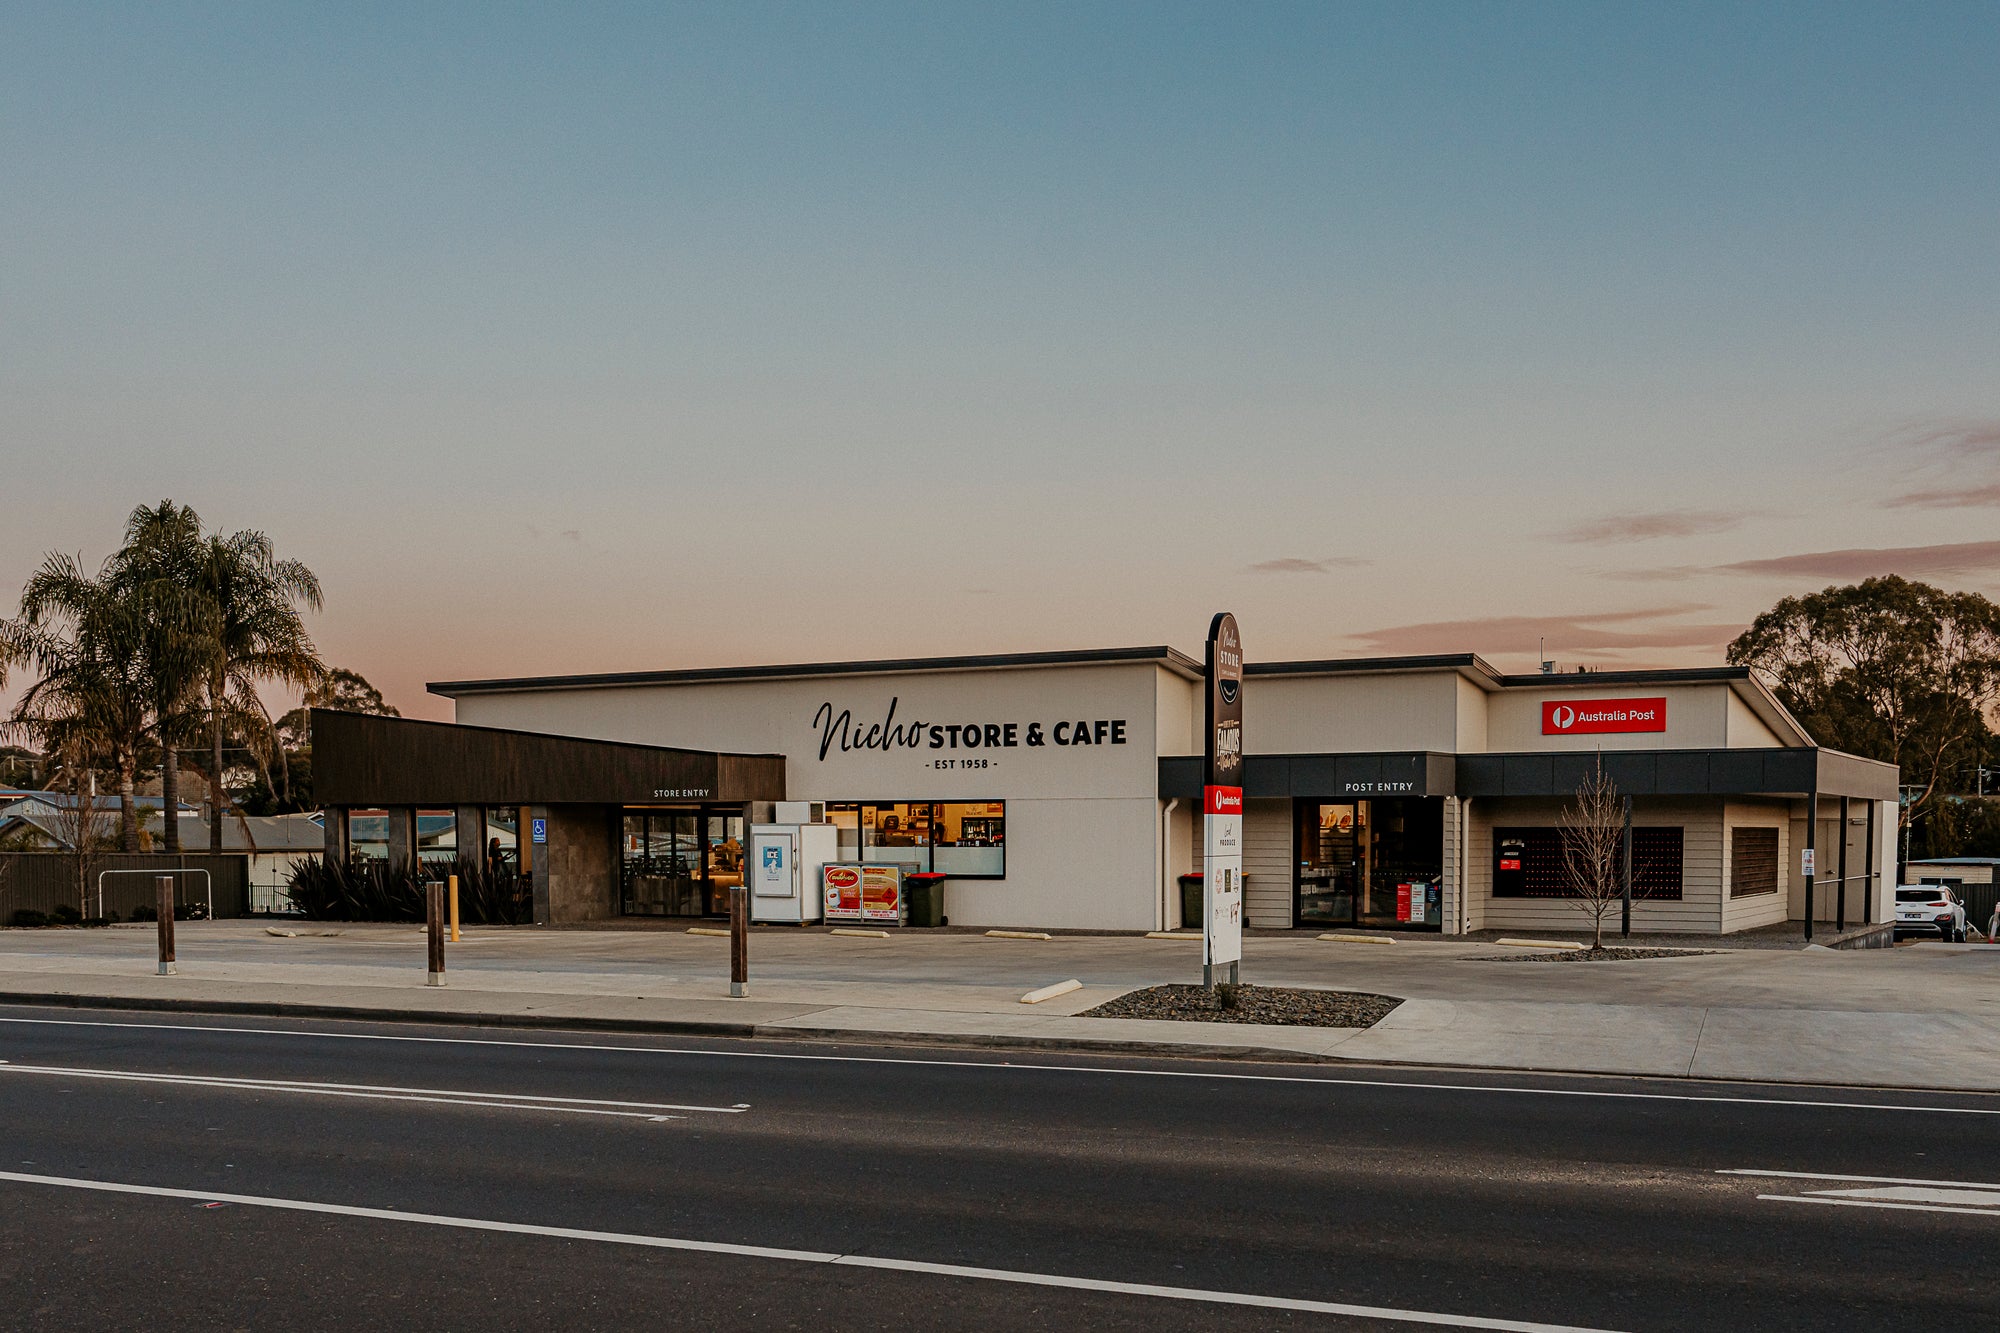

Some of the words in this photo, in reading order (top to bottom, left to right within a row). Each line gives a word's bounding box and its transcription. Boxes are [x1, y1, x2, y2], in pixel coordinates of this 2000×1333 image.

[1220, 650, 1239, 668] STORE
[1578, 710, 1627, 722] Australia
[1629, 709, 1655, 721] Post
[813, 696, 930, 762] Nicho
[928, 723, 1018, 749] STORE
[1026, 722, 1046, 747] &
[1053, 719, 1127, 746] CAFE
[934, 759, 956, 769] EST
[960, 759, 988, 769] 1958
[1345, 782, 1374, 792] POST
[1377, 782, 1413, 791] ENTRY
[653, 789, 680, 798] STORE
[682, 789, 709, 797] ENTRY
